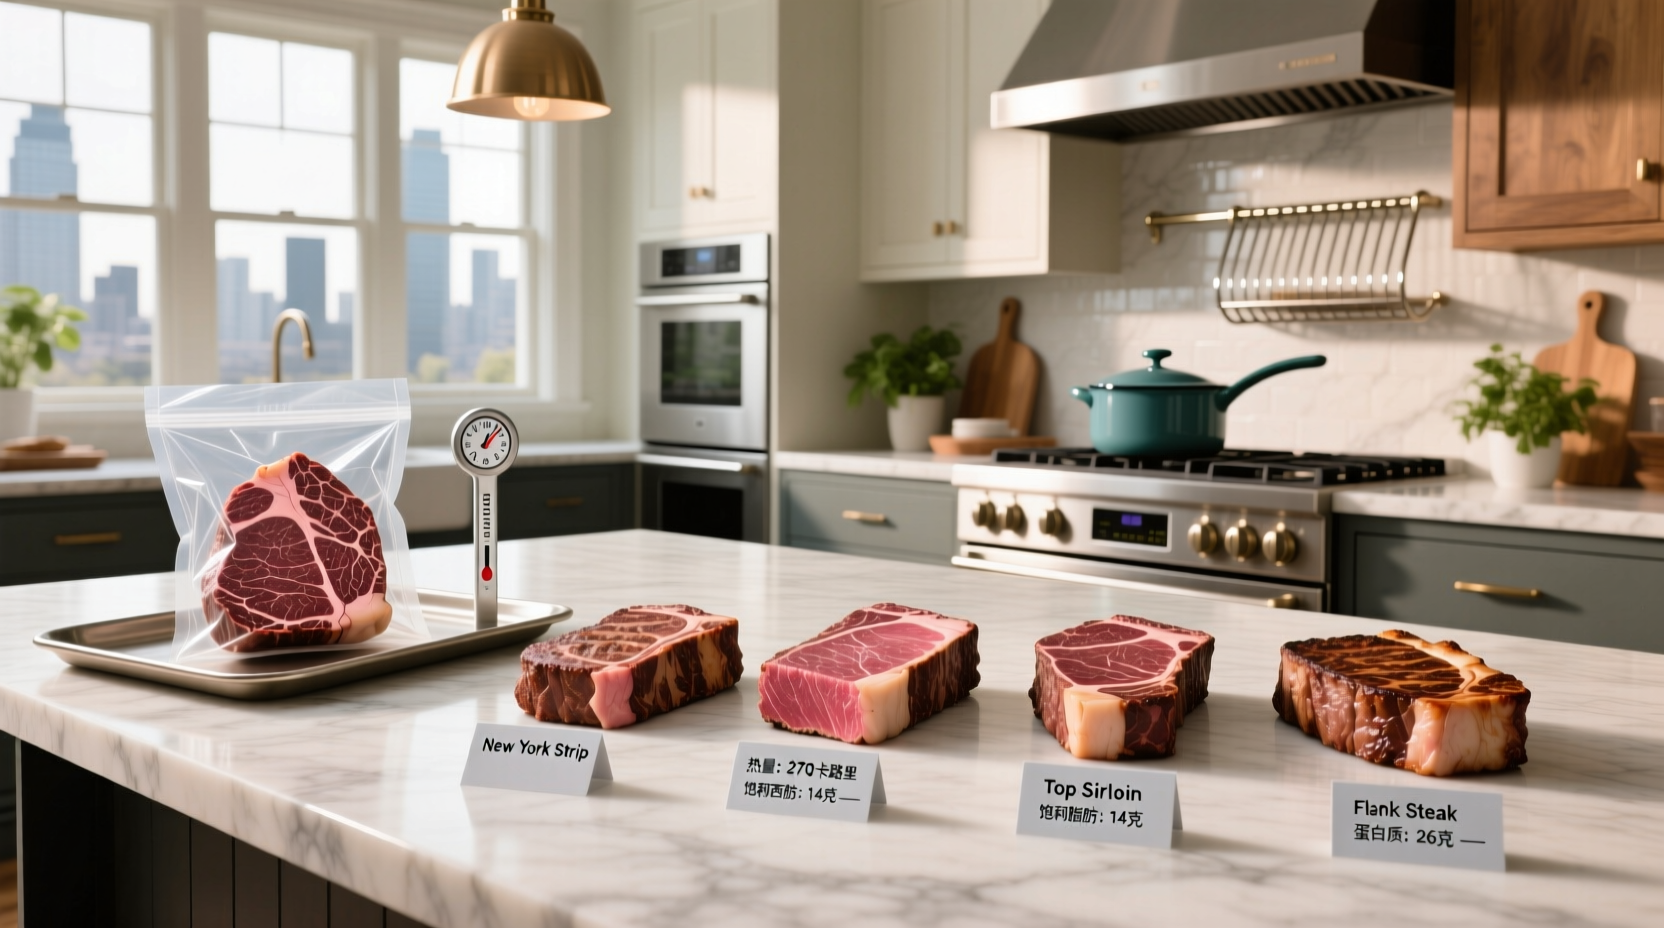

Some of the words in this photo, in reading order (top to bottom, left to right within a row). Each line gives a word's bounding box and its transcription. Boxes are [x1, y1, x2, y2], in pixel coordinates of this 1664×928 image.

[482, 737, 515, 753] New
[520, 739, 551, 756] York
[554, 743, 589, 762] Strip
[1044, 779, 1077, 801] Top
[1082, 781, 1142, 802] Sirloin
[1354, 799, 1401, 818] Flank
[1406, 802, 1458, 822] Steak
